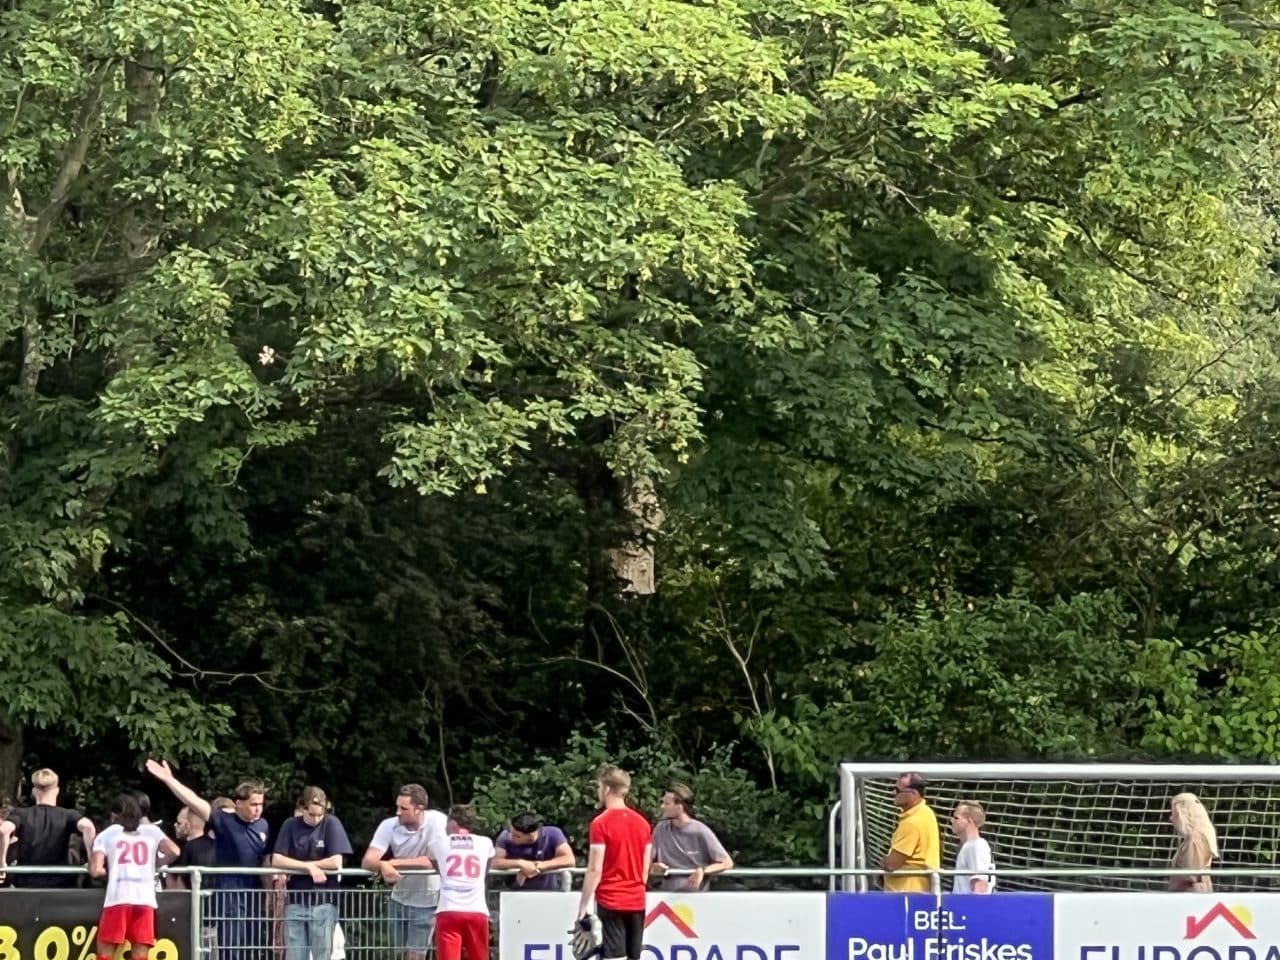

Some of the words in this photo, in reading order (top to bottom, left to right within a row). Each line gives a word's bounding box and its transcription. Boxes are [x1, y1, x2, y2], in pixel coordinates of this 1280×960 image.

[116, 840, 149, 866] 20
[446, 855, 481, 878] 26
[914, 910, 967, 930] BEL:
